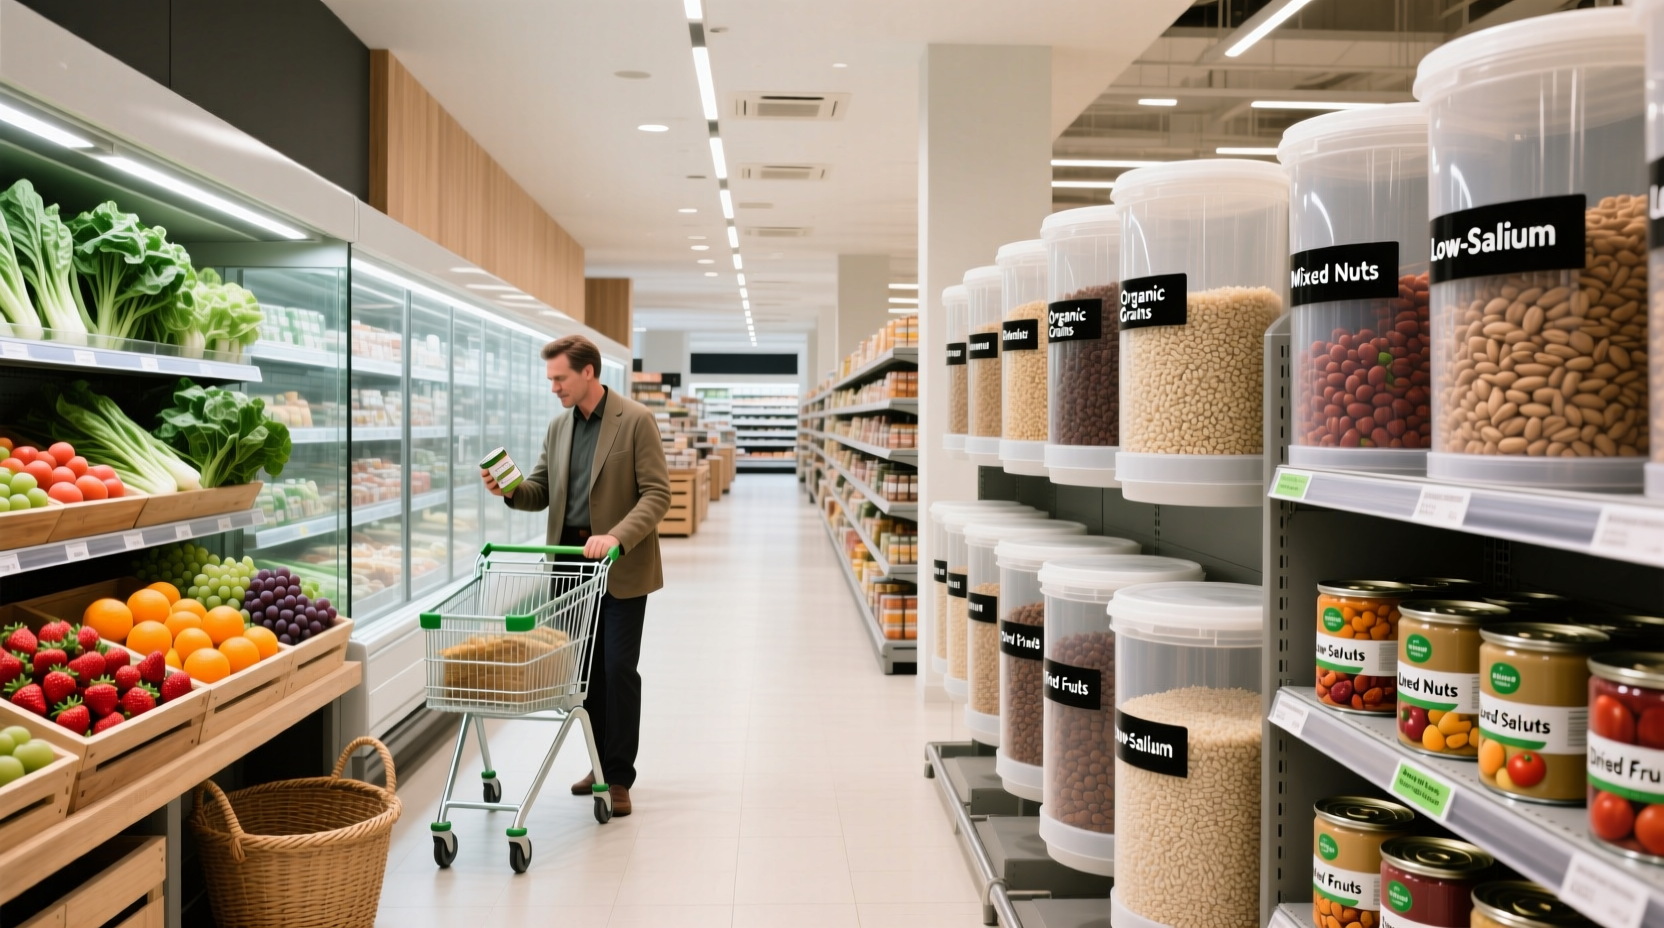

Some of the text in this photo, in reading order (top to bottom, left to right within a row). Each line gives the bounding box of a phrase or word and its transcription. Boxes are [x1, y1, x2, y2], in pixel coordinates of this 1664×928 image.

[1430, 220, 1556, 262] Low-Salium
[1335, 260, 1379, 282] Nuts
[1120, 284, 1166, 309] Organic
[1423, 678, 1459, 698] Nuts
[1501, 711, 1551, 735] Saluts
